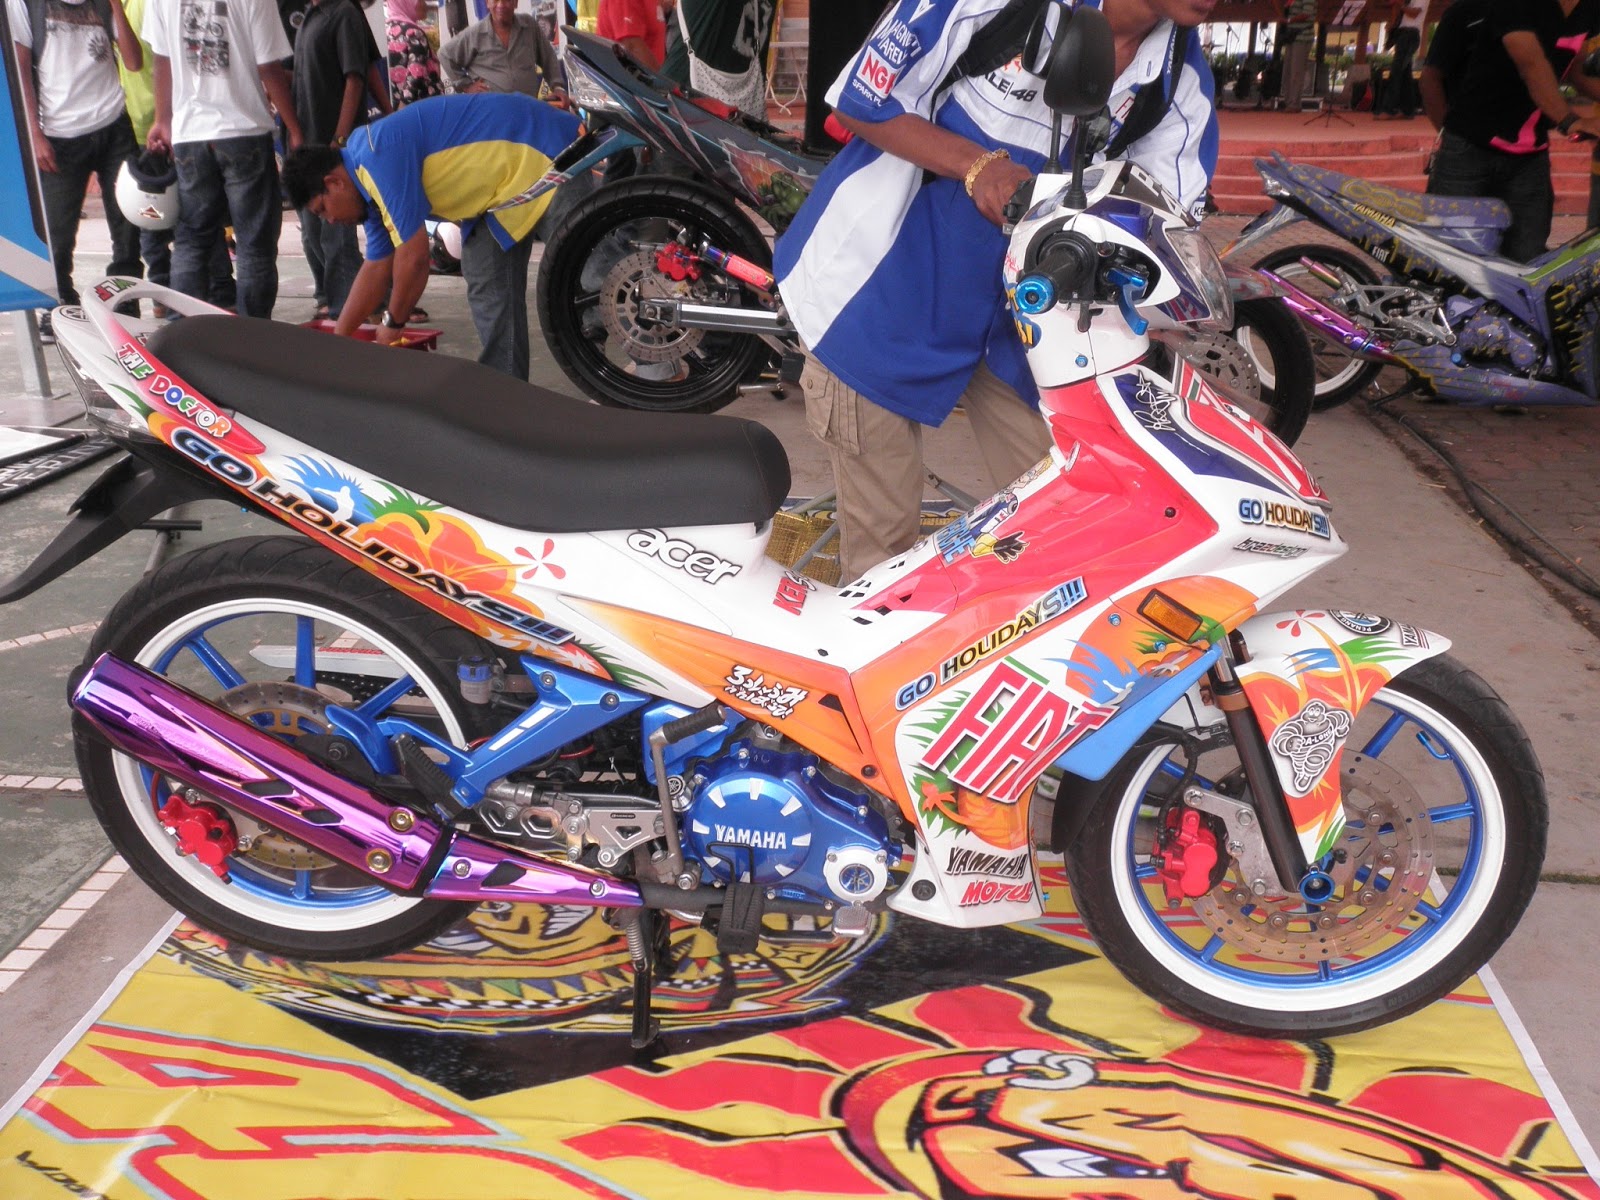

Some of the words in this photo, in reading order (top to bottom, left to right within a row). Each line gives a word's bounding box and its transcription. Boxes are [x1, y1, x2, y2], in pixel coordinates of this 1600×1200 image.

[1353, 203, 1396, 228] YAMAHA
[1371, 246, 1390, 262] FIAT
[117, 343, 155, 379] THE
[150, 375, 232, 437] DOCTOR
[173, 429, 256, 486] GO
[250, 476, 575, 644] HOLIDAYS!!!
[1238, 498, 1263, 523] GO
[1264, 500, 1330, 537] HOLIDAYS!!!
[627, 528, 742, 584] acer
[896, 673, 935, 710] GO
[941, 577, 1086, 683] HOLIDAYS!!!
[919, 661, 1118, 803] FIAT
[715, 824, 787, 849] YAMAHA
[945, 846, 1028, 877] YAMAHA
[959, 880, 1034, 907] MOTUL
